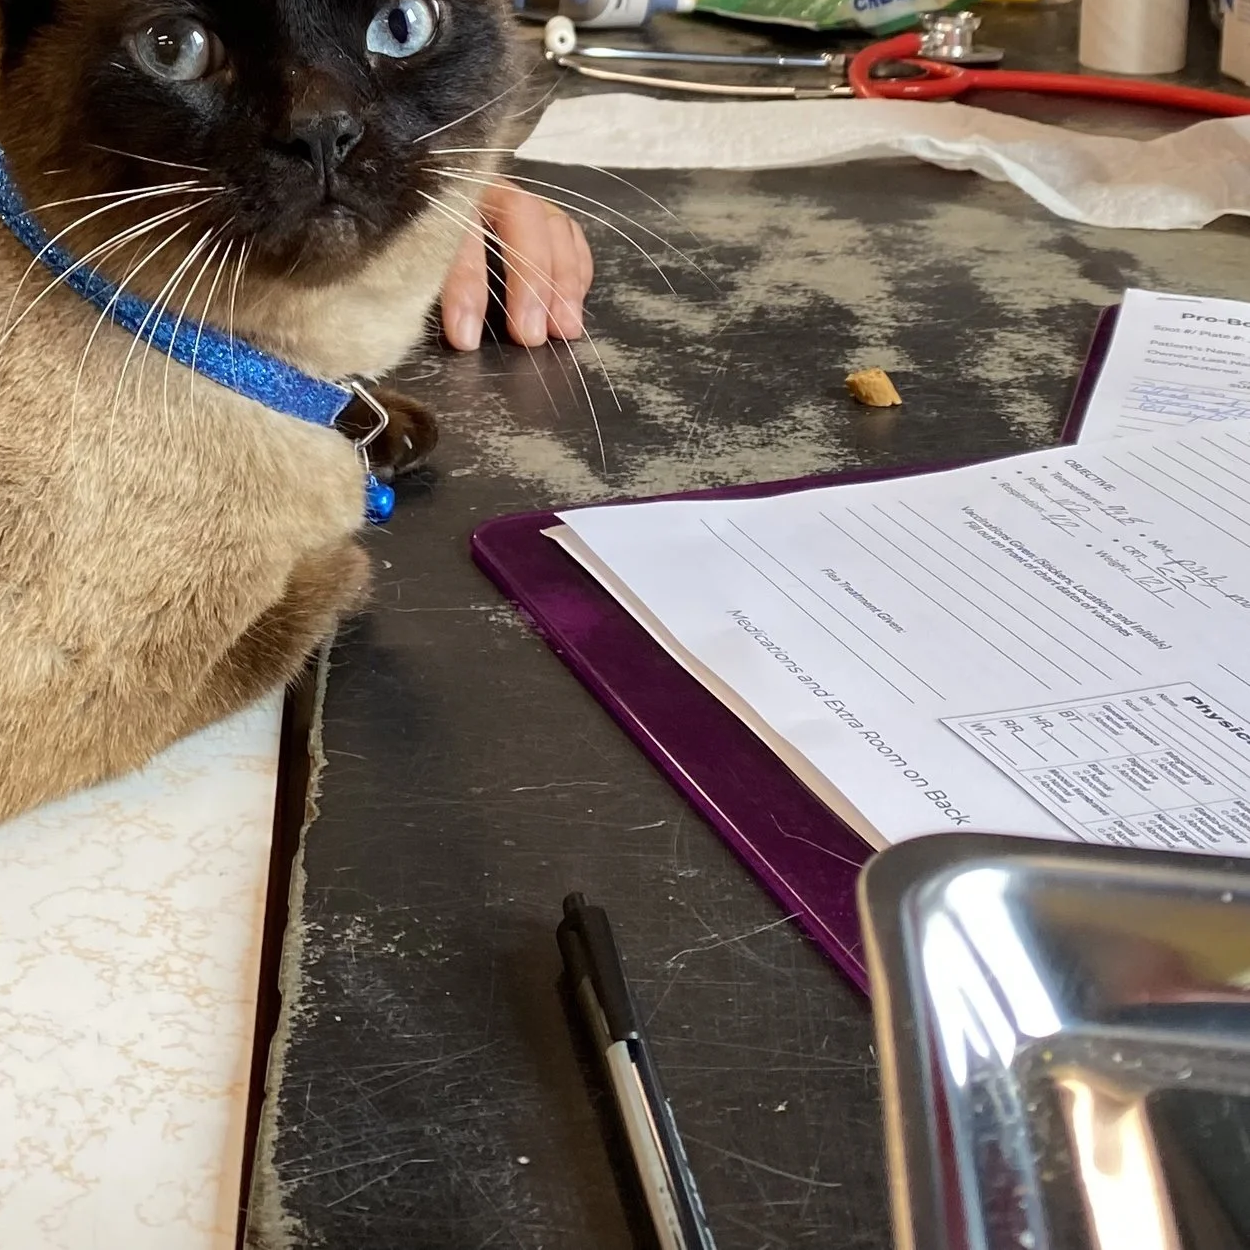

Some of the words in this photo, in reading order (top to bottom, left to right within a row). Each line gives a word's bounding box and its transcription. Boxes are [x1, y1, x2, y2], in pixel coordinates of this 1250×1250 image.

[1150, 340, 1203, 352] Patient's
[1024, 477, 1053, 495] Pulse:
[1050, 471, 1104, 507] Temperature:
[1064, 459, 1117, 493] OBJECTIVE:
[998, 482, 1047, 513] Respiration:
[1094, 550, 1132, 575] Weight:
[1121, 545, 1148, 560] CRT:
[961, 505, 1012, 541] Vaccinations
[1111, 612, 1138, 626] and
[1130, 625, 1173, 650] Initials)
[963, 520, 985, 531] Fill
[976, 530, 996, 541] out
[991, 540, 1006, 549] on
[1002, 547, 1029, 564] front
[1033, 570, 1062, 586] chart
[1055, 585, 1084, 603] dates
[1080, 602, 1098, 610] of
[1090, 609, 1134, 637] vaccines
[820, 567, 841, 583] Flea
[837, 579, 882, 615] Treatment
[876, 610, 907, 634] Given:
[726, 609, 804, 674] Medications
[797, 673, 836, 698] and
[823, 698, 864, 730] Extra
[859, 730, 907, 768] Room
[902, 767, 929, 789] on
[923, 788, 971, 826] Back
[969, 722, 997, 737] WT
[1058, 710, 1084, 722] BT
